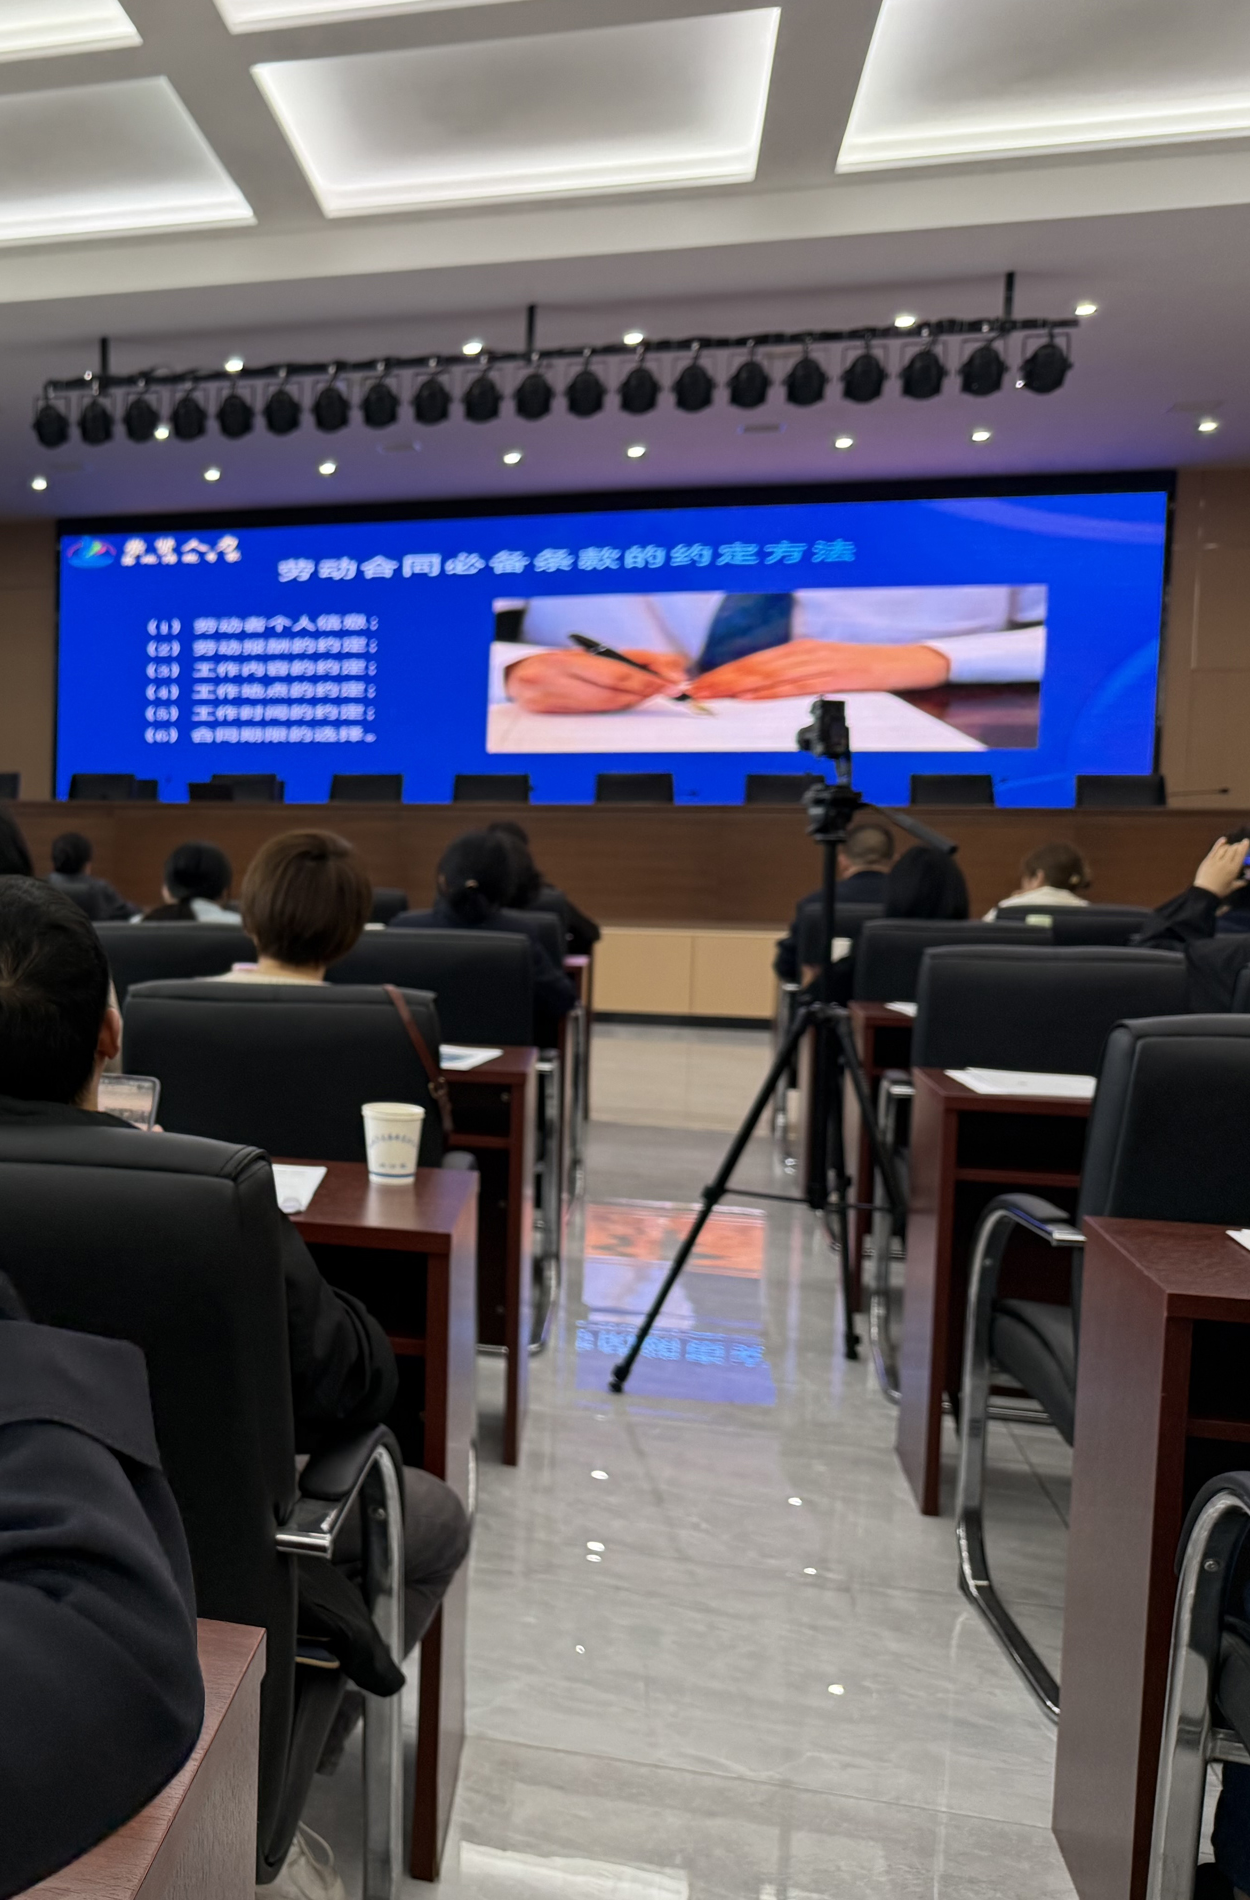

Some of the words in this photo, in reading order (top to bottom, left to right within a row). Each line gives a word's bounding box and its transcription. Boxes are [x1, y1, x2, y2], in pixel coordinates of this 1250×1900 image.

[277, 538, 857, 583] 劳动合同必备条款的约定方法
